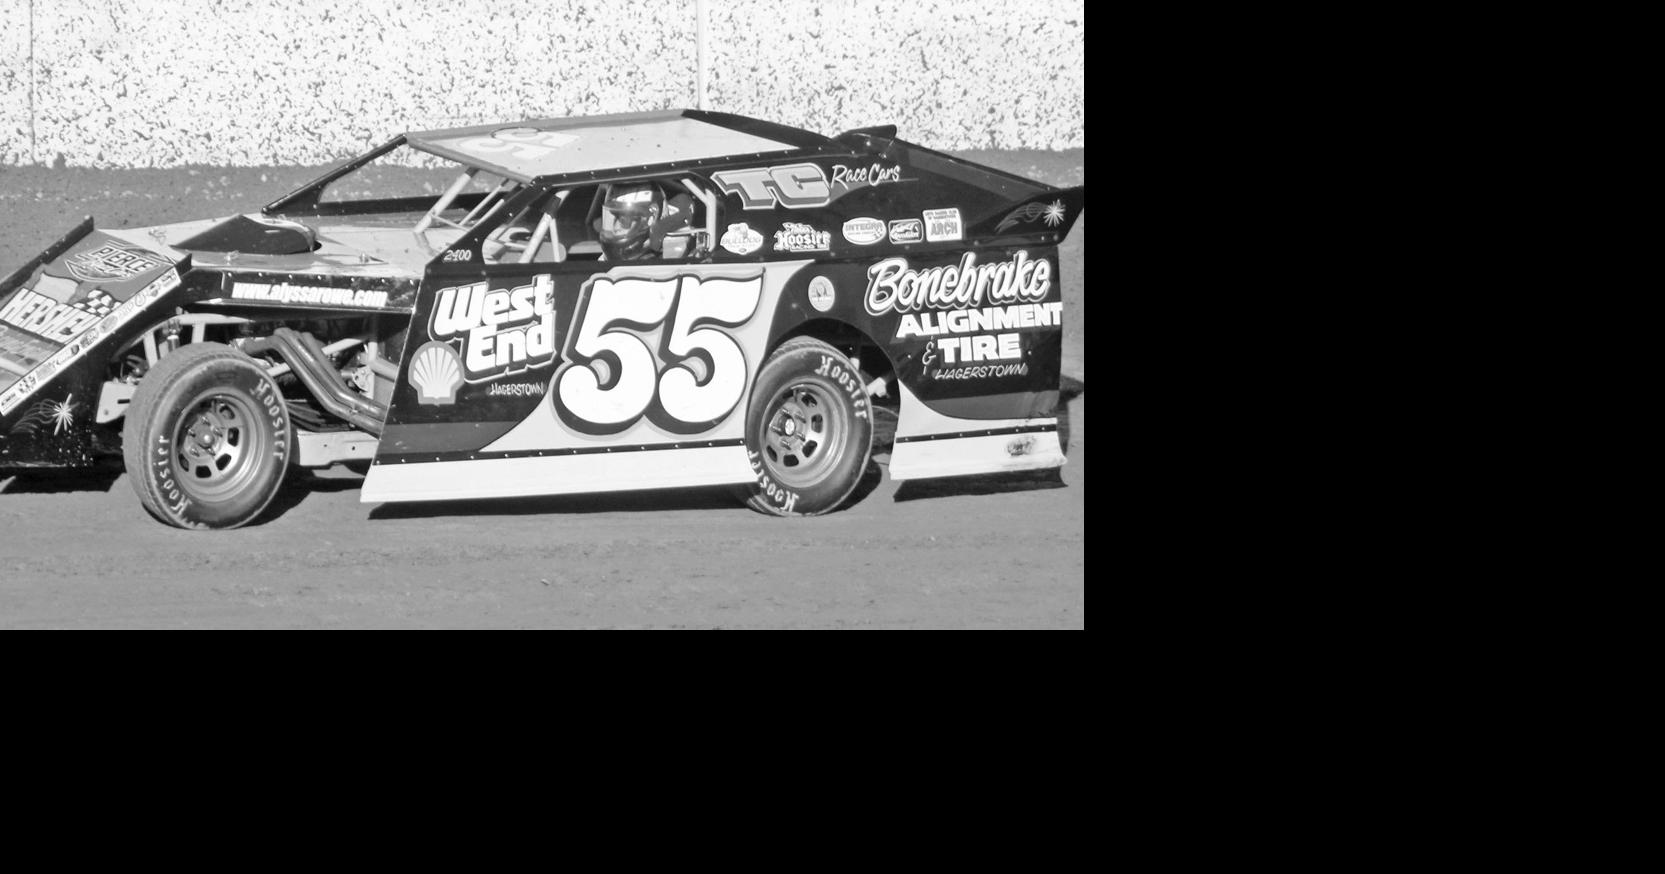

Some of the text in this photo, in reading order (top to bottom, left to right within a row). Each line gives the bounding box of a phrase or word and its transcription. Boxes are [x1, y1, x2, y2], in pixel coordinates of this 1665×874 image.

[710, 162, 832, 210] TC
[831, 163, 901, 190] Race Cars
[773, 230, 831, 250] Hoosier
[930, 222, 958, 236] ARCH
[90, 245, 159, 275] PIERCE
[443, 249, 472, 261] 2400
[864, 250, 1051, 316] Bonebrake
[430, 275, 554, 338] West
[895, 302, 1063, 339] ALIGNMENT
[464, 311, 556, 376] End
[555, 274, 763, 432] 55
[921, 333, 1022, 376] & TIRE
[489, 383, 545, 396] HAGERSTOWN
[814, 355, 868, 420] Hoosier
[935, 363, 1028, 380] HAGERSTOWN
[250, 378, 286, 462] Hoosier
[153, 434, 194, 516] Hoosier
[749, 450, 800, 513] Hoosier
